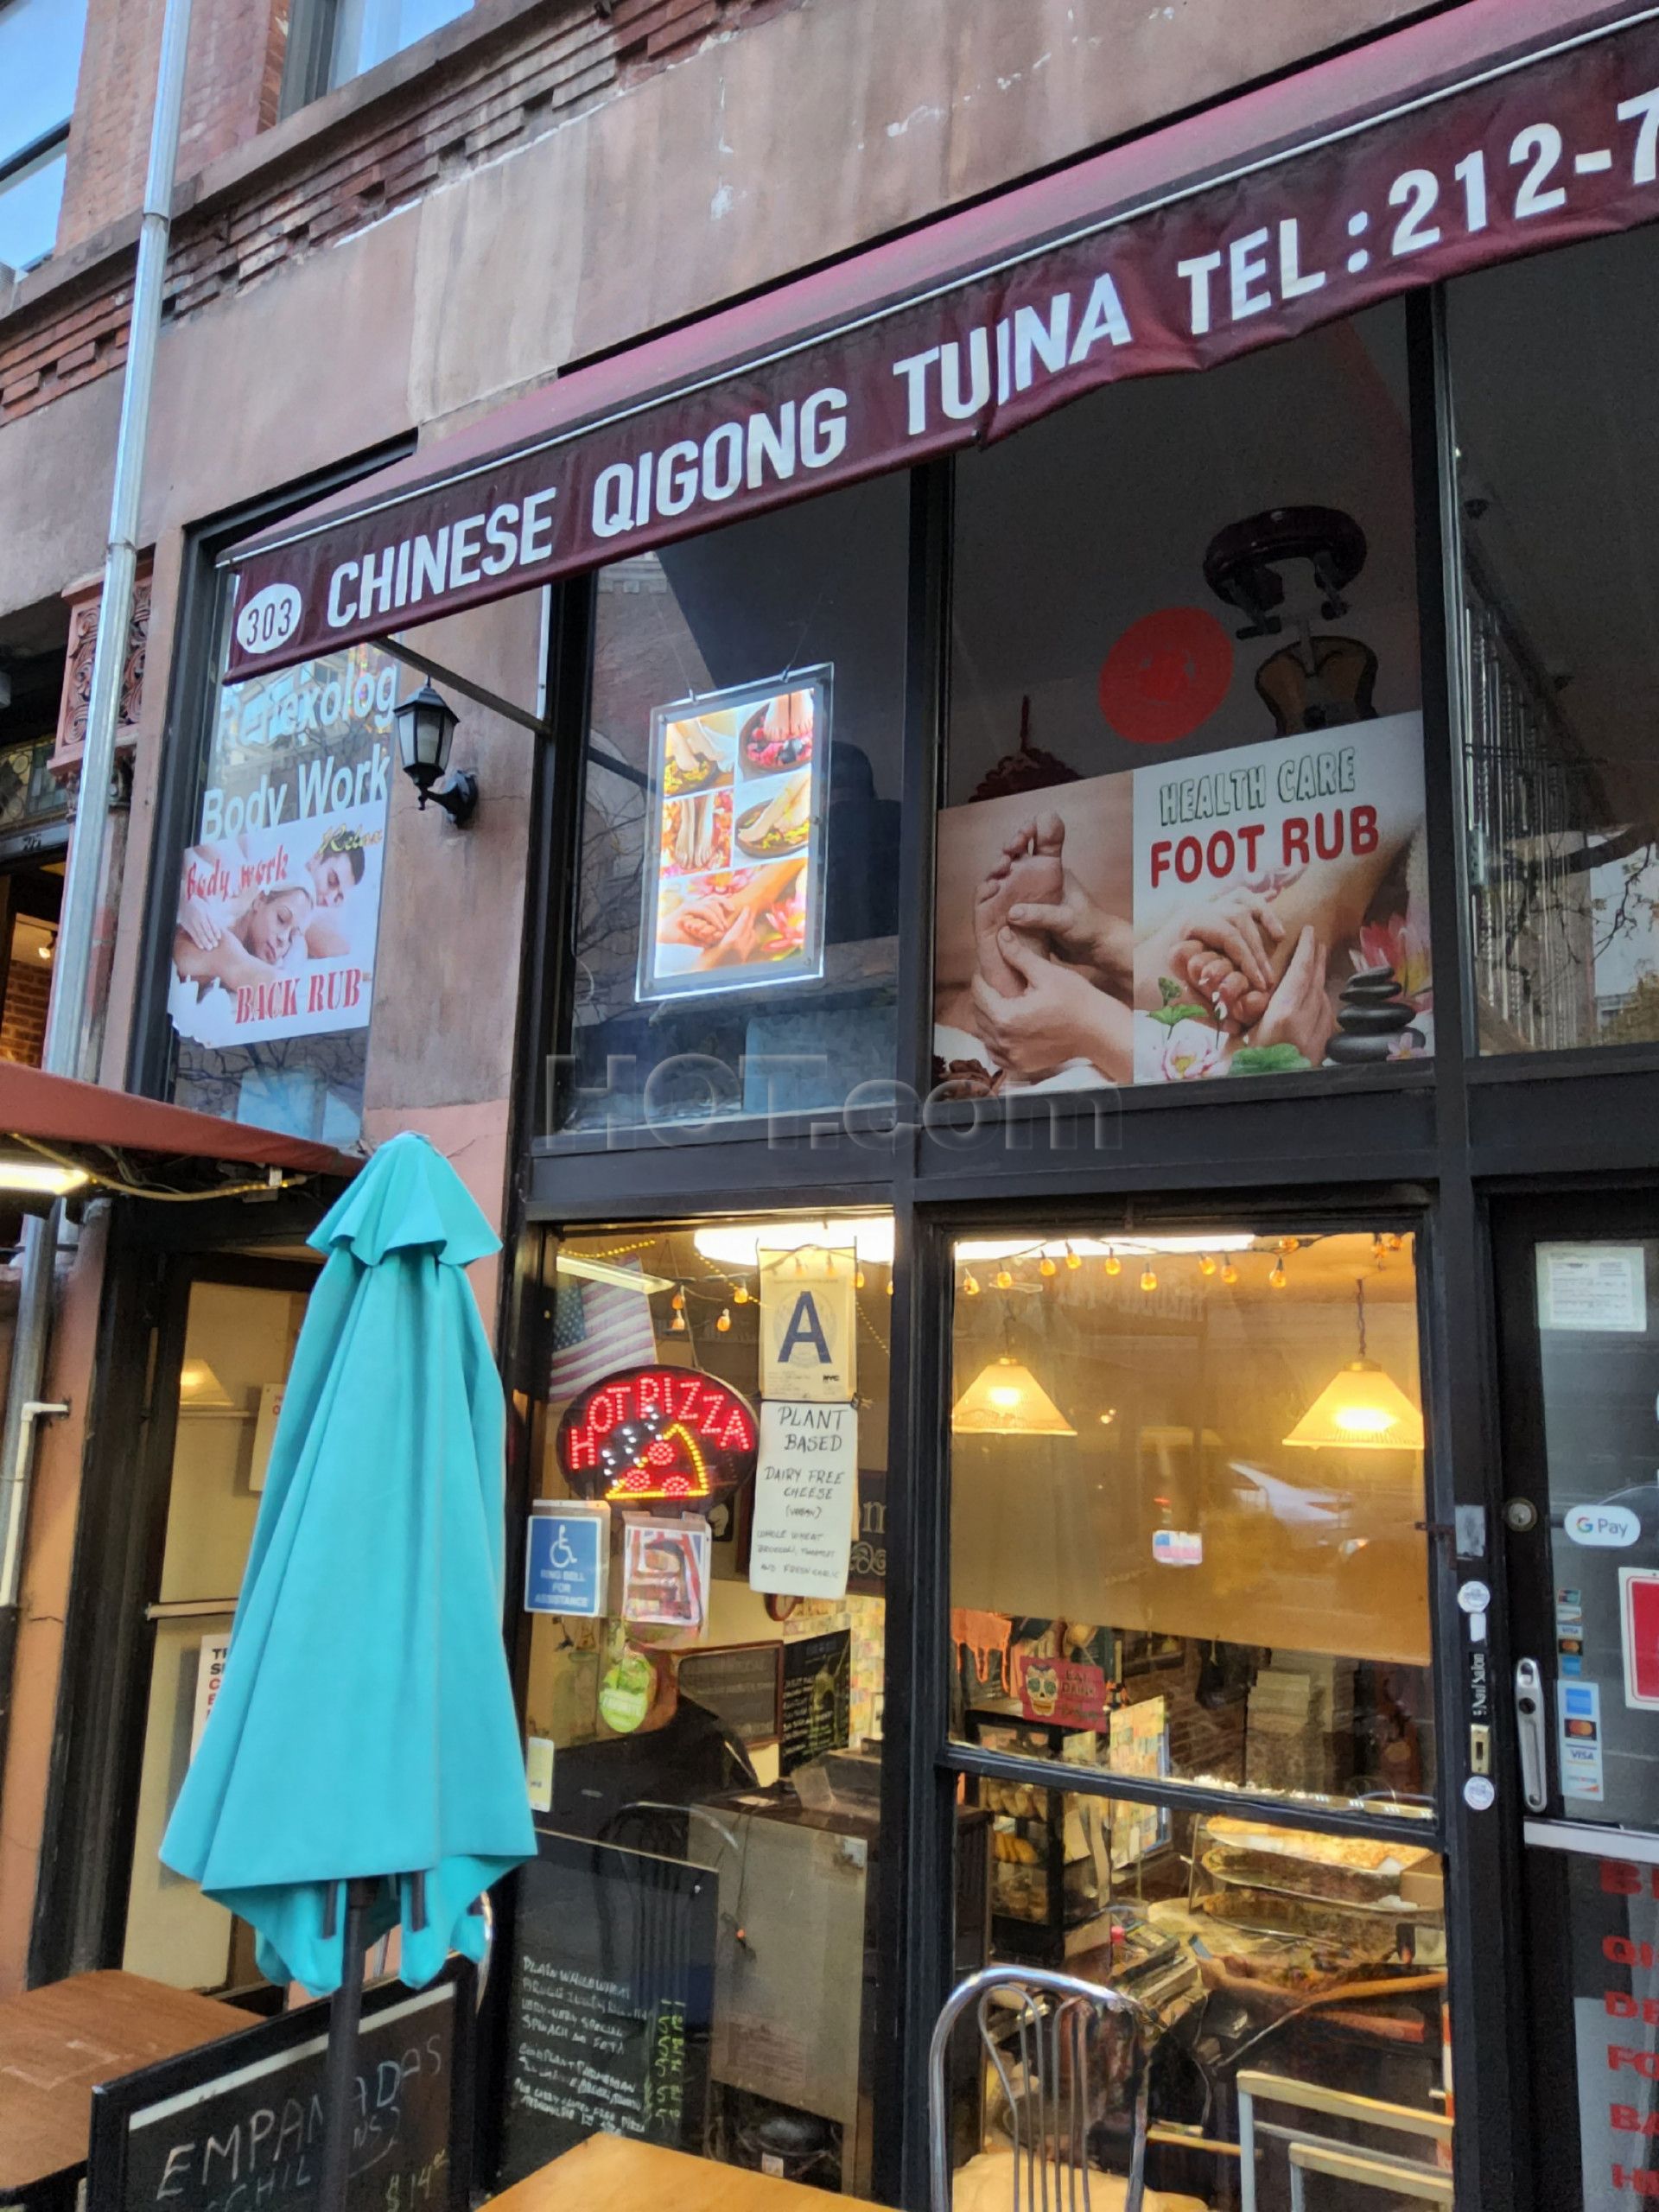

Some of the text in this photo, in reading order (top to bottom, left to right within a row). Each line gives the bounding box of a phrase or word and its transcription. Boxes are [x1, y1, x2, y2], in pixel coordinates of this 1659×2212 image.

[246, 600, 292, 646] 303
[328, 487, 558, 628] CHINESE
[592, 387, 848, 538] QIGONG
[893, 273, 1131, 435] TUINA
[298, 743, 391, 819] Work
[1160, 747, 1357, 827] HEALTH CARE
[1151, 805, 1379, 888] FOOT RUB
[235, 968, 361, 1026] BACK RUB
[777, 1290, 833, 1364] A
[570, 1376, 751, 1470] HOT PIZZA
[778, 1405, 849, 1431] PLANT
[784, 1433, 842, 1453] BASED
[765, 1465, 845, 1484] DAIRY FREE
[784, 1486, 832, 1500] CHEESE
[1598, 1517, 1628, 1539] Pay
